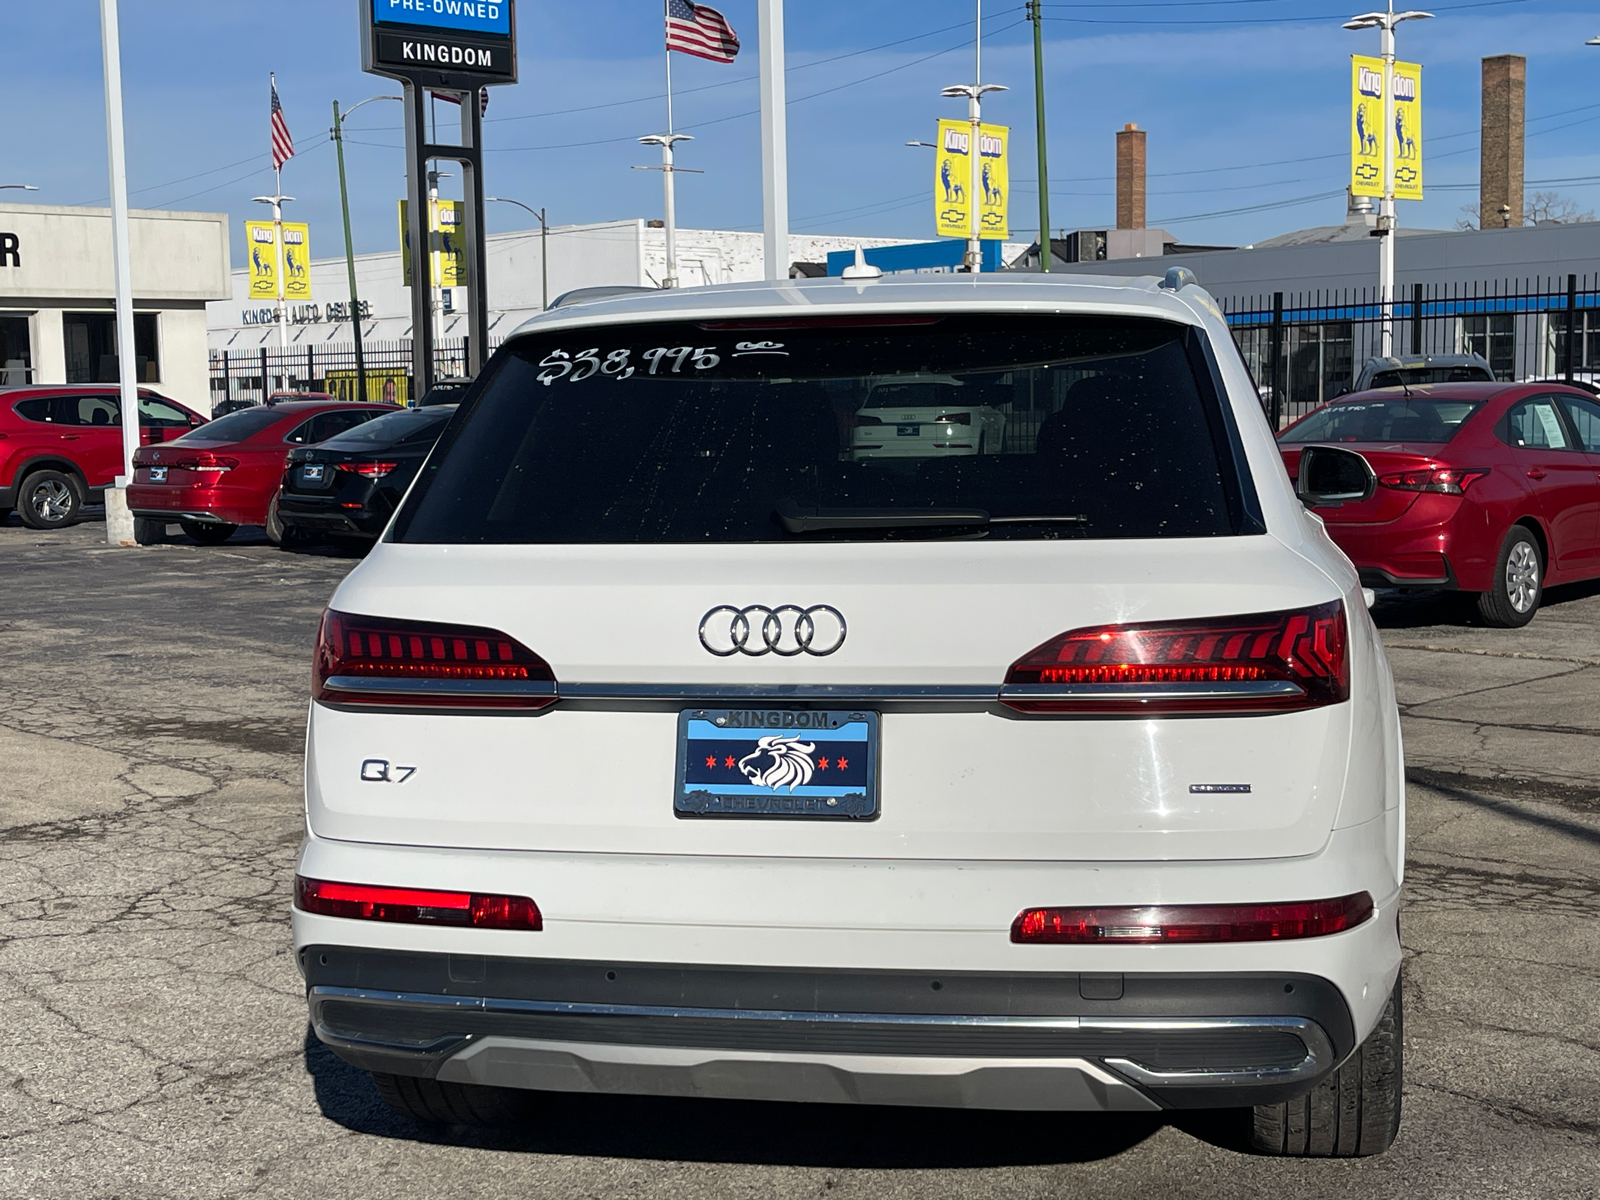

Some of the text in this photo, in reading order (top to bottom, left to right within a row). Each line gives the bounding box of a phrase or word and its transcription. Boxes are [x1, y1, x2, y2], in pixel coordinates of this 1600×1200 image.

[390, 0, 499, 19] PRE-OWNED
[402, 42, 492, 67] KINGDOM
[1358, 66, 1415, 101] King dom
[944, 128, 1003, 158] King dom
[1355, 180, 1380, 188] CHEVROLET
[252, 227, 304, 245] King dom
[0, 232, 20, 268] R
[292, 303, 319, 325] AUTO
[536, 347, 720, 386] $38,995
[727, 710, 829, 728] KINGDOM
[360, 759, 417, 783] Q7
[721, 795, 825, 811] CHEVROLET
